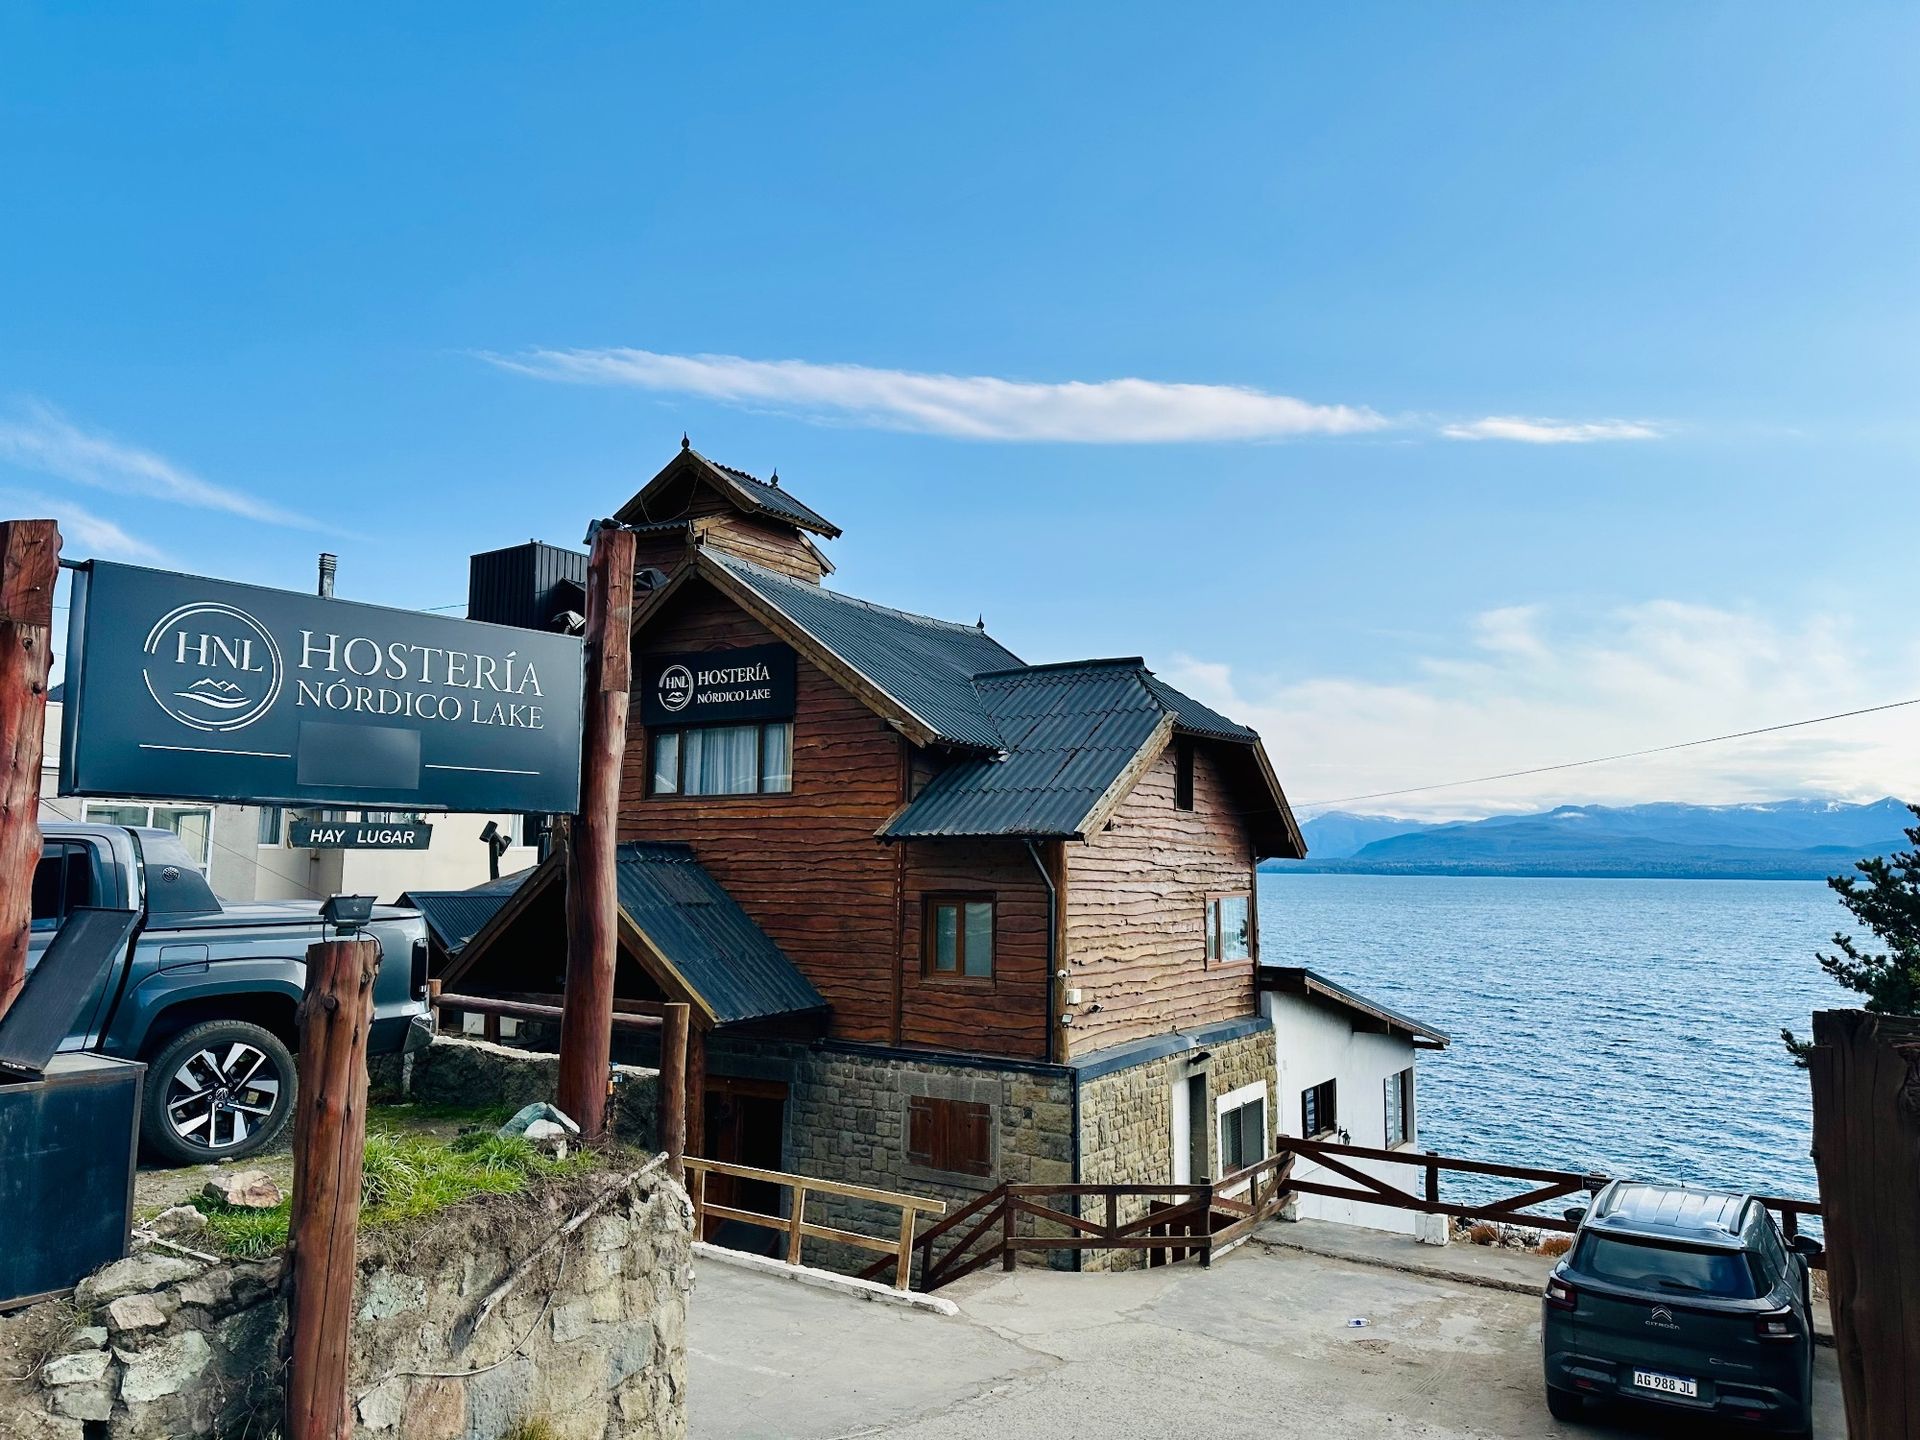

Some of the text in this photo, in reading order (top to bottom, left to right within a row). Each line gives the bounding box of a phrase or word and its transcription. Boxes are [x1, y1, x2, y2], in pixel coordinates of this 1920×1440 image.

[175, 631, 264, 672] HNL
[298, 629, 545, 697] HOSTERÍA
[665, 675, 689, 689] HNL
[697, 662, 771, 686] HOSTERÍA
[296, 678, 545, 730] NÓRDICO LAKE
[697, 688, 771, 704] NÓRDICO LAKE
[309, 829, 415, 844] HAY LUGAR
[1636, 1373, 1651, 1386] AG
[1654, 1377, 1676, 1391] 988
[1679, 1383, 1694, 1395] JL
